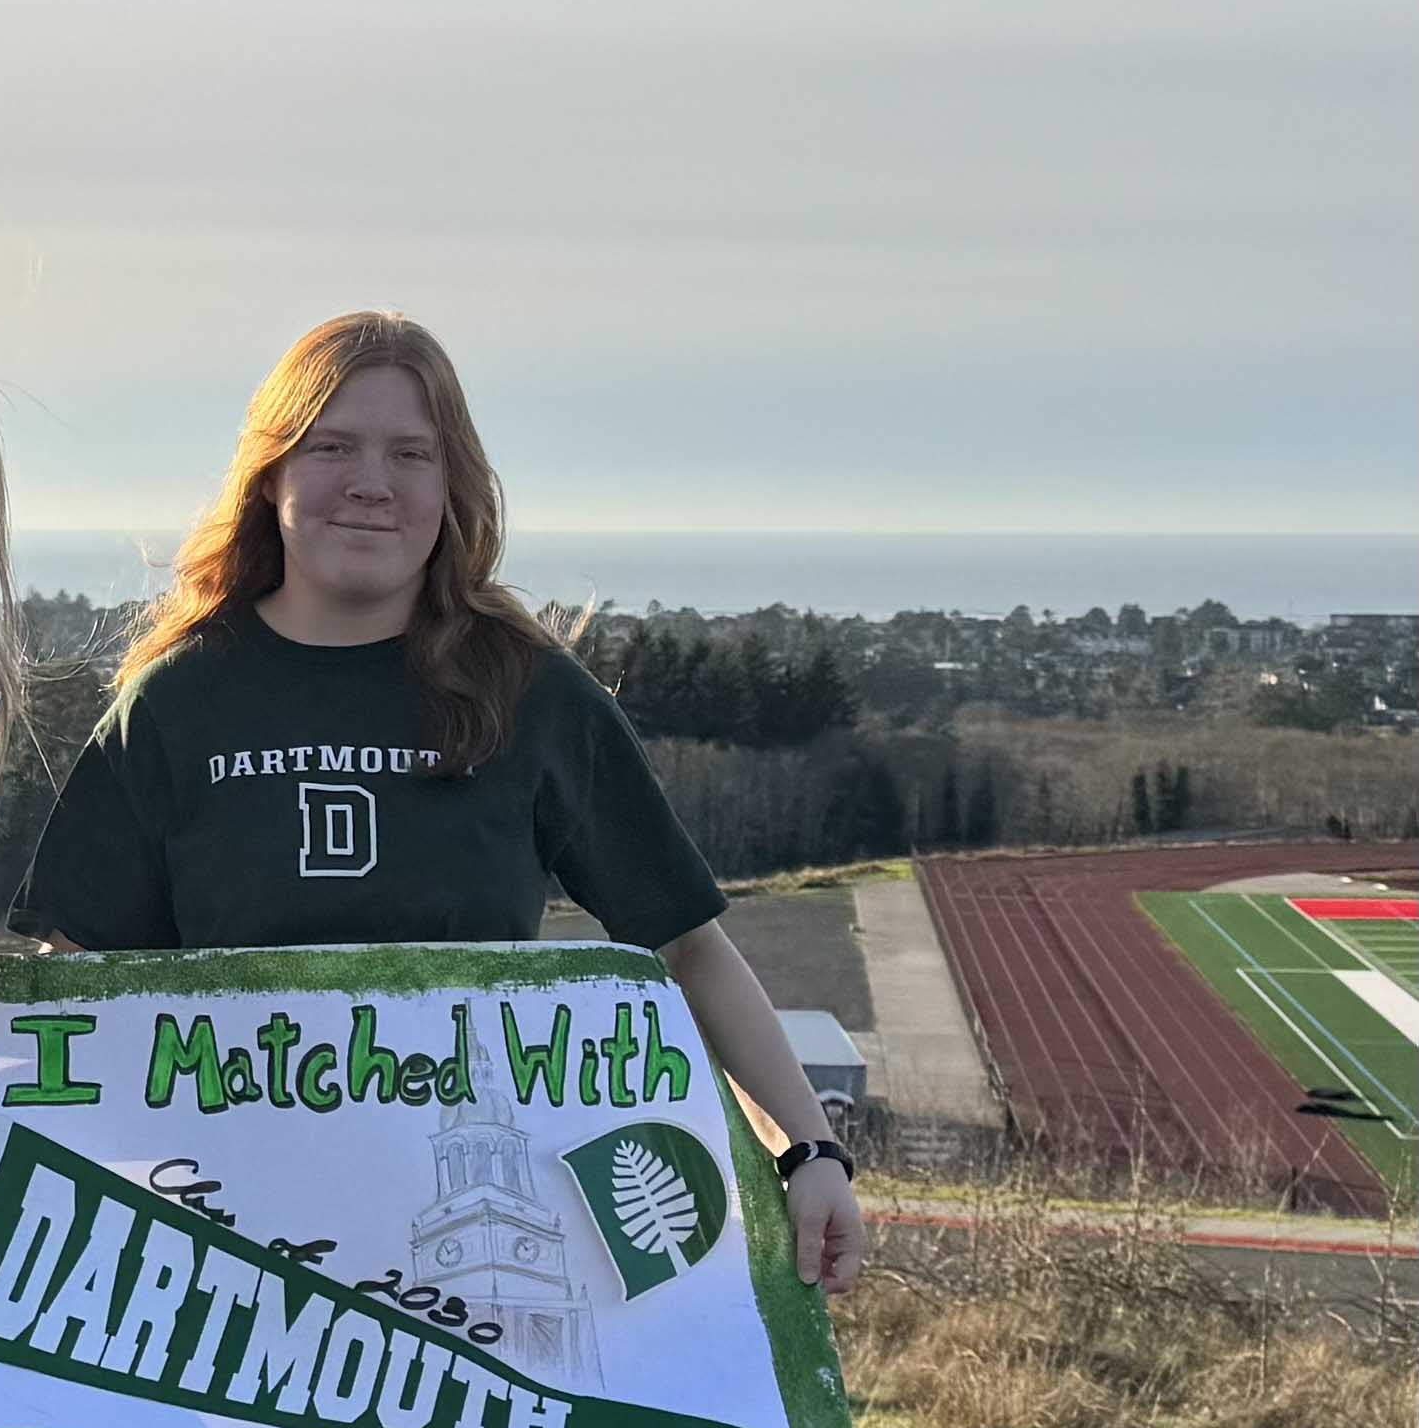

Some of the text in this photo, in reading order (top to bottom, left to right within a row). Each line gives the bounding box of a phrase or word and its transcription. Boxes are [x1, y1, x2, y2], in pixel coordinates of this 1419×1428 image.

[208, 745, 475, 785] DARTMOUT
[299, 782, 378, 878] D
[2, 1001, 691, 1114] I Matched With
[355, 1269, 504, 1345] 2030
